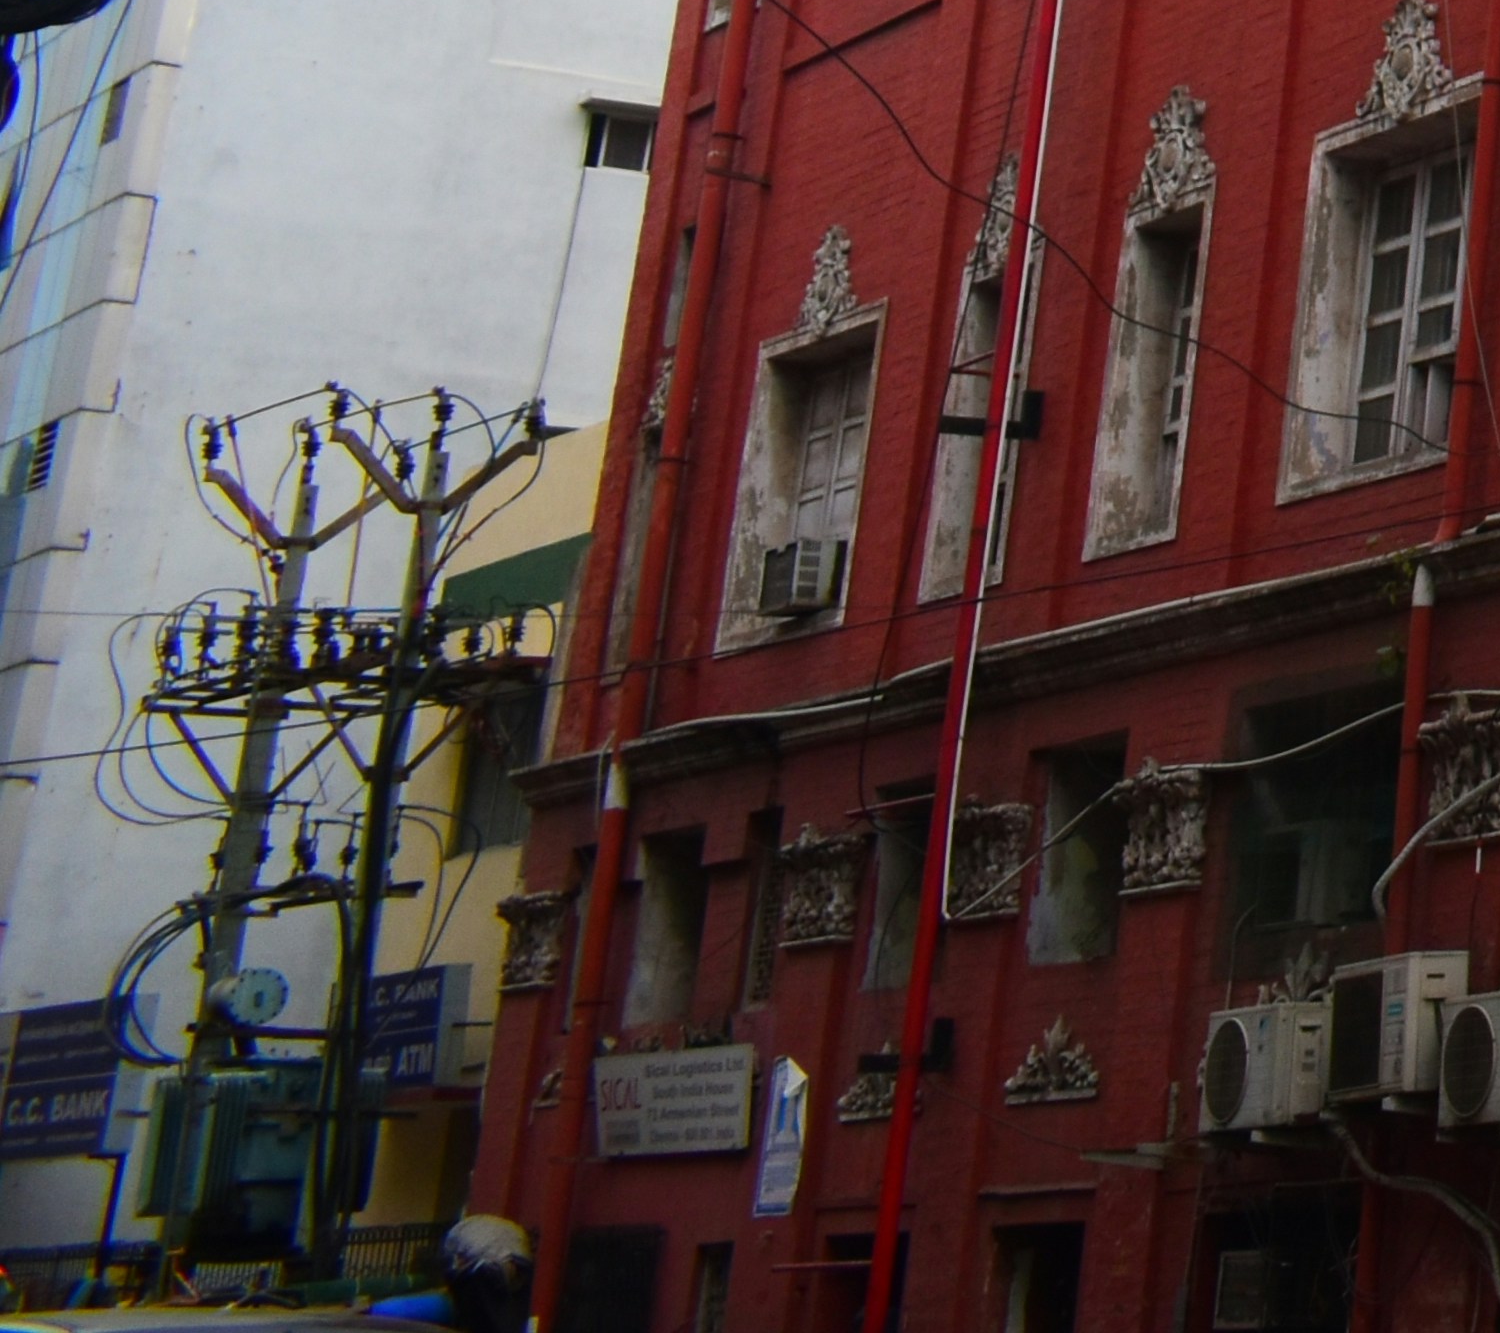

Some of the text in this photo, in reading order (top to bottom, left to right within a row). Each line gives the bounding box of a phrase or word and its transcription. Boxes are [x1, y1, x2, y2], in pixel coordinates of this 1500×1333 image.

[396, 1042, 435, 1077] ATM
[672, 1059, 724, 1078] Logistics
[51, 1090, 110, 1121] BANK
[601, 1077, 642, 1112] SICAL
